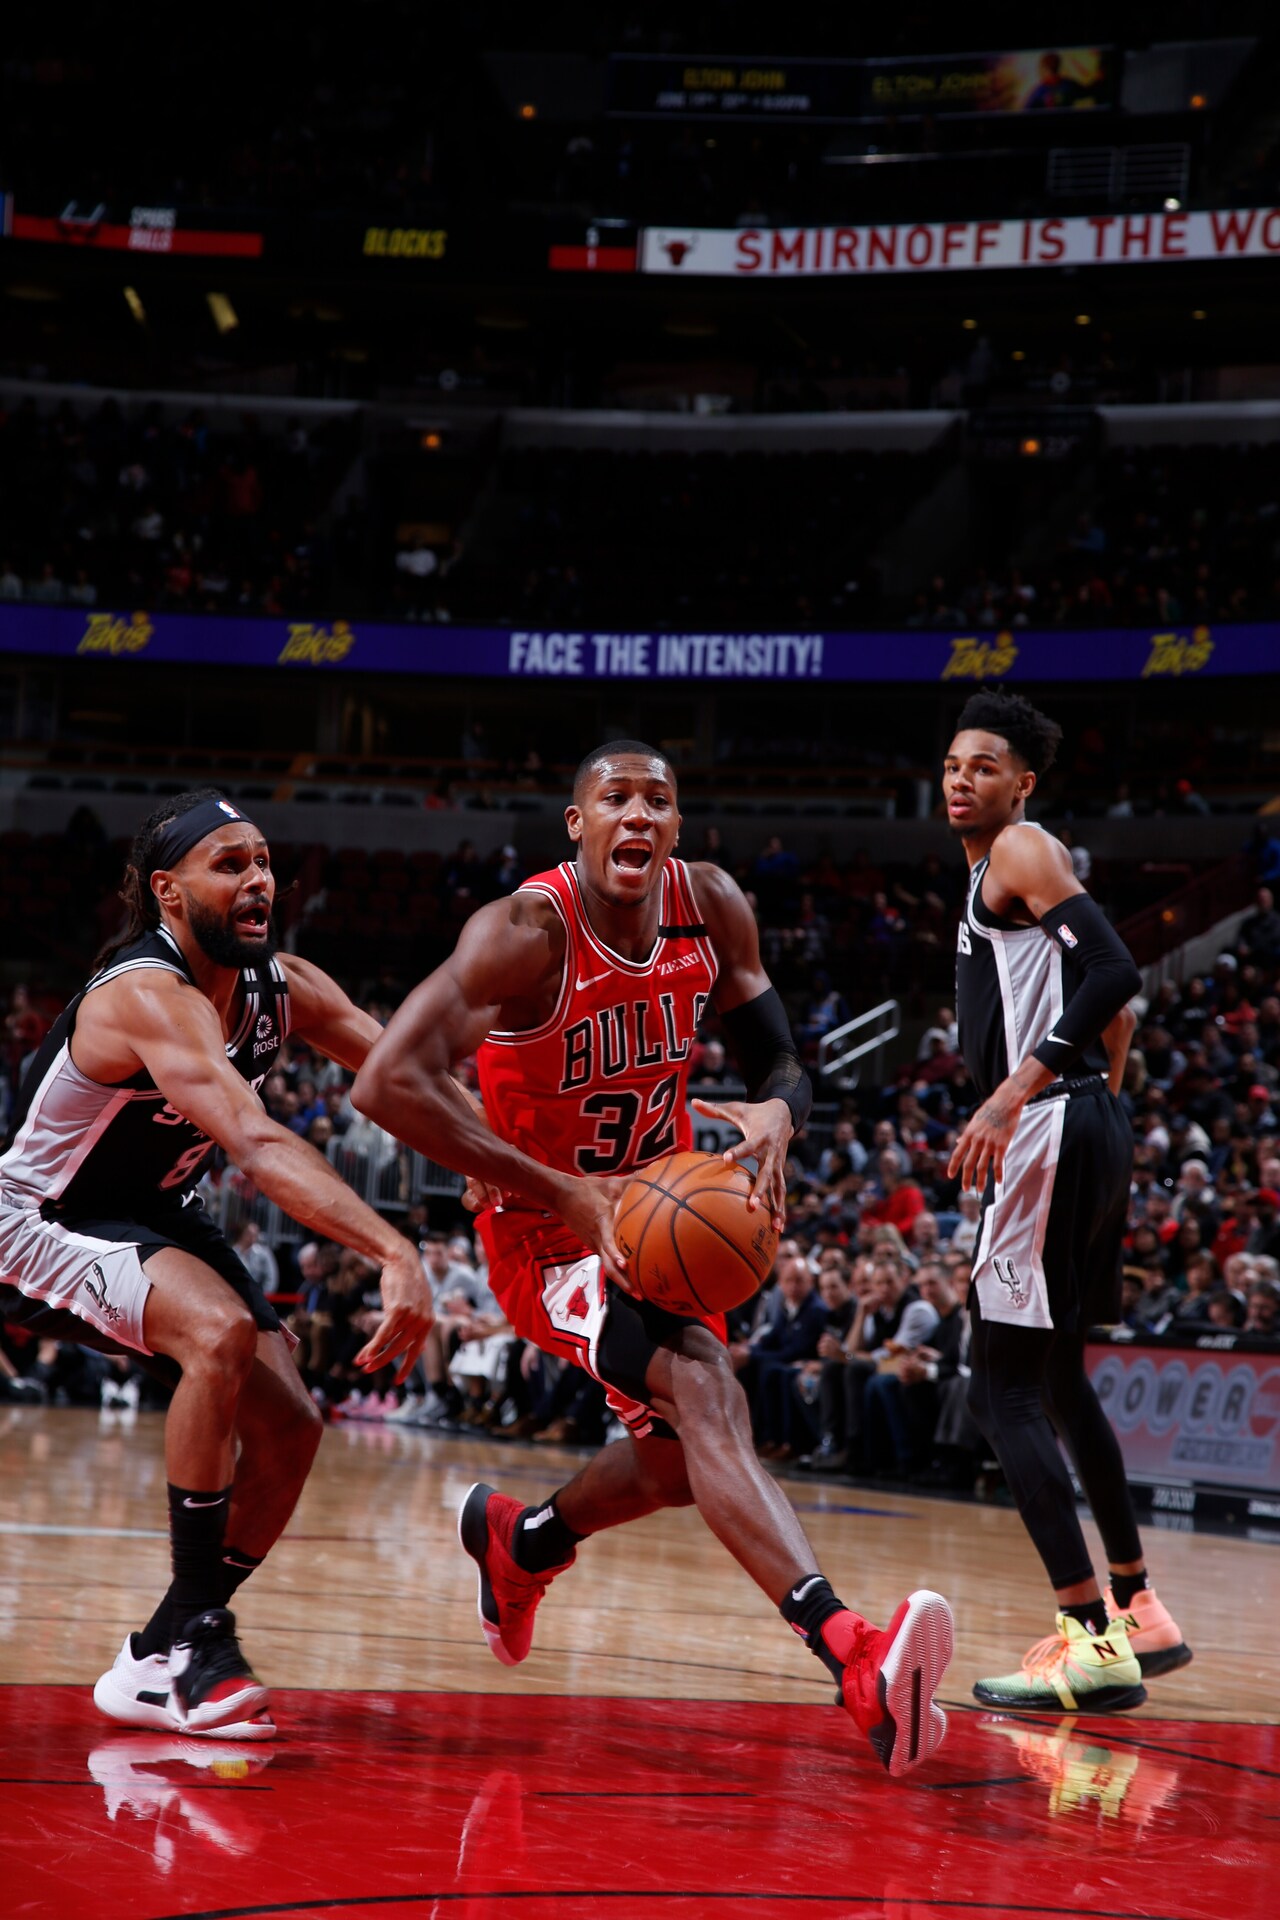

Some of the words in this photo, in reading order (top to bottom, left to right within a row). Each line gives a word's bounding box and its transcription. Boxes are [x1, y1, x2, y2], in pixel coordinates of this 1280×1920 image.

[363, 227, 447, 258] BLOCKS
[735, 221, 1002, 273] SMIRNOFF
[1021, 217, 1066, 266] IS
[1087, 212, 1190, 261] THE
[509, 632, 585, 674] FACE
[591, 634, 650, 675] THE
[657, 634, 823, 676] INTENSITY!
[657, 951, 700, 976] ZENNI
[574, 1069, 678, 1177] 32
[1099, 1375, 1246, 1425] POWER
